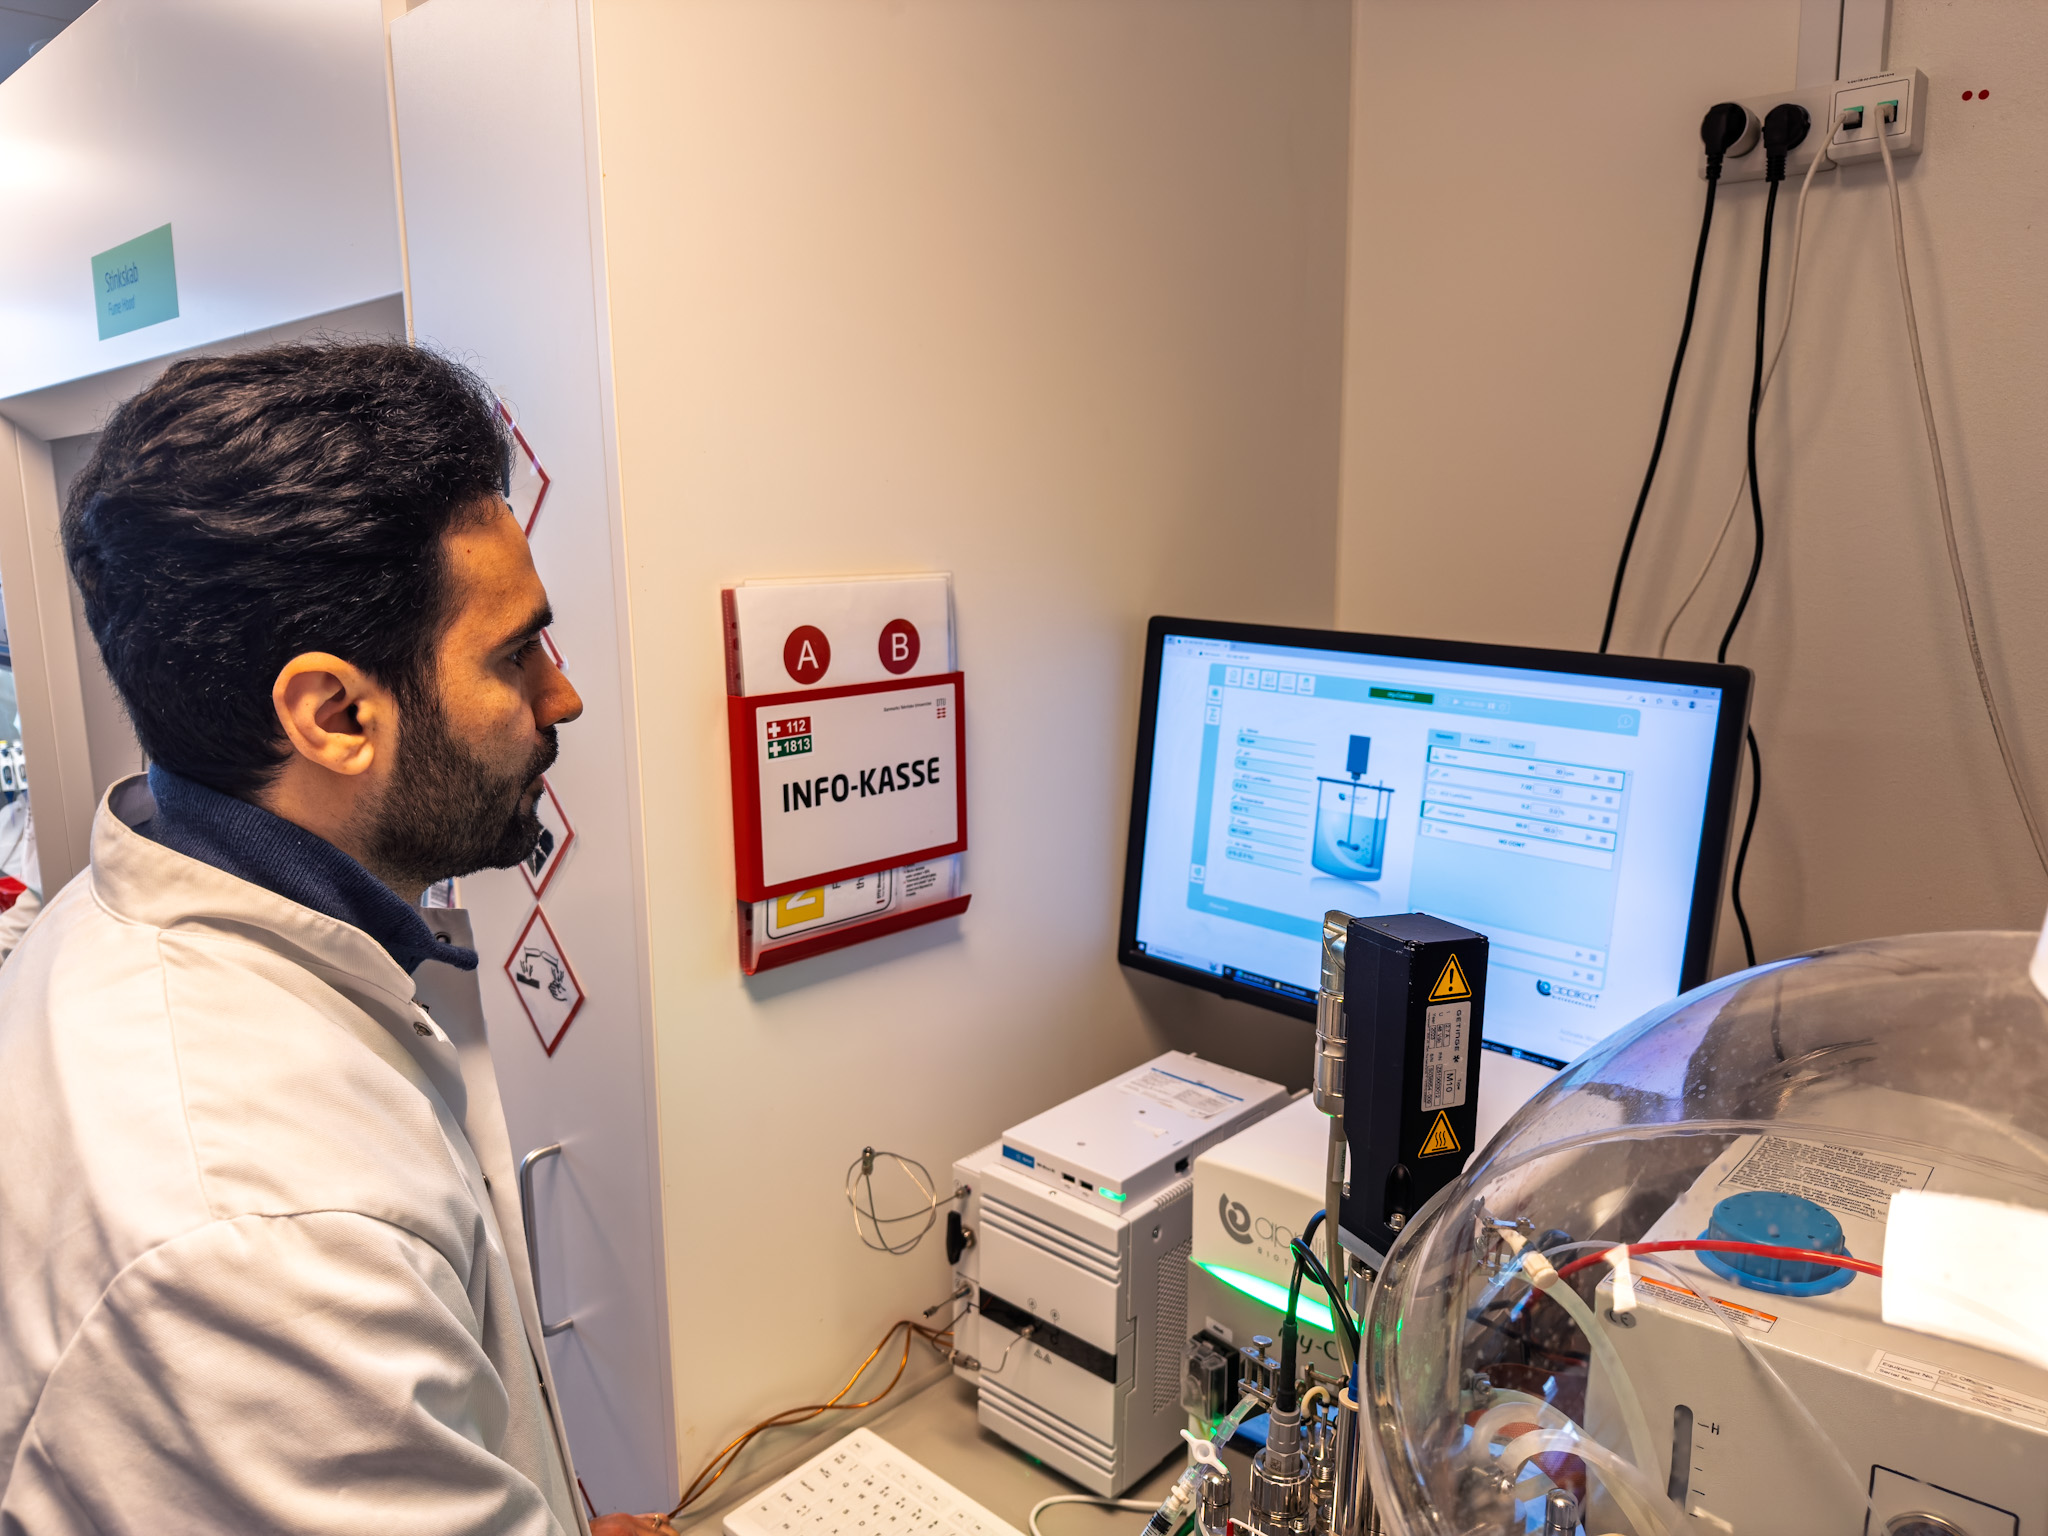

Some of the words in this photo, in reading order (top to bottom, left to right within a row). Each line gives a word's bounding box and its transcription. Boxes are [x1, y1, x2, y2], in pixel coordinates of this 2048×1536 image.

[105, 261, 139, 293] Stinkskab
[797, 640, 819, 670] A
[892, 633, 909, 661] B
[936, 698, 946, 707] DTU
[786, 719, 806, 735] 112
[783, 738, 811, 753] 1813
[783, 757, 940, 813] INFO-KASSE
[1454, 1010, 1462, 1051] GETINGE
[1446, 1073, 1454, 1092] M10
[1879, 1368, 1900, 1379] Serial
[1882, 1362, 1921, 1376] Equipment
[1711, 1422, 1720, 1435] H
